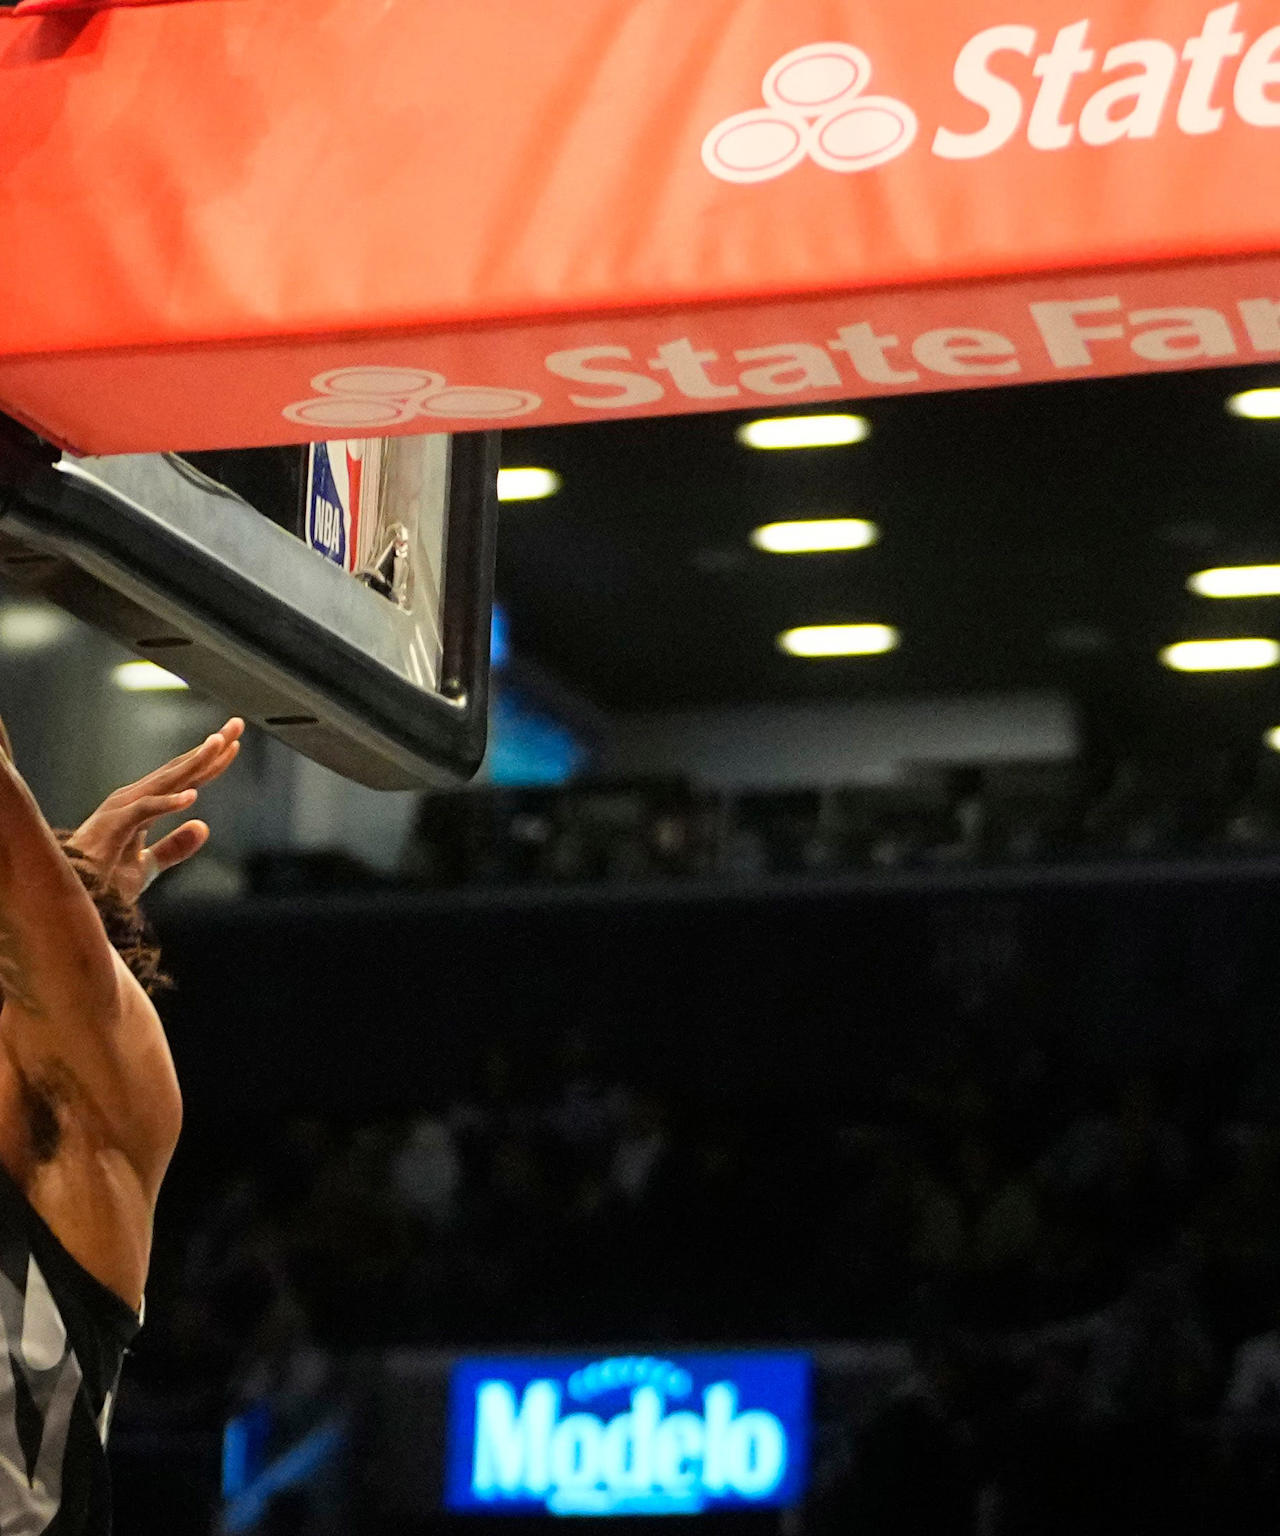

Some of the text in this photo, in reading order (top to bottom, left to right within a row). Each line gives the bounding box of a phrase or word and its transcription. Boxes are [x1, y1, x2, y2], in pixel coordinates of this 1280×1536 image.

[931, 1, 1280, 160] State
[545, 322, 1021, 408] State
[314, 494, 341, 555] NBA
[472, 1378, 788, 1499] Modelo
